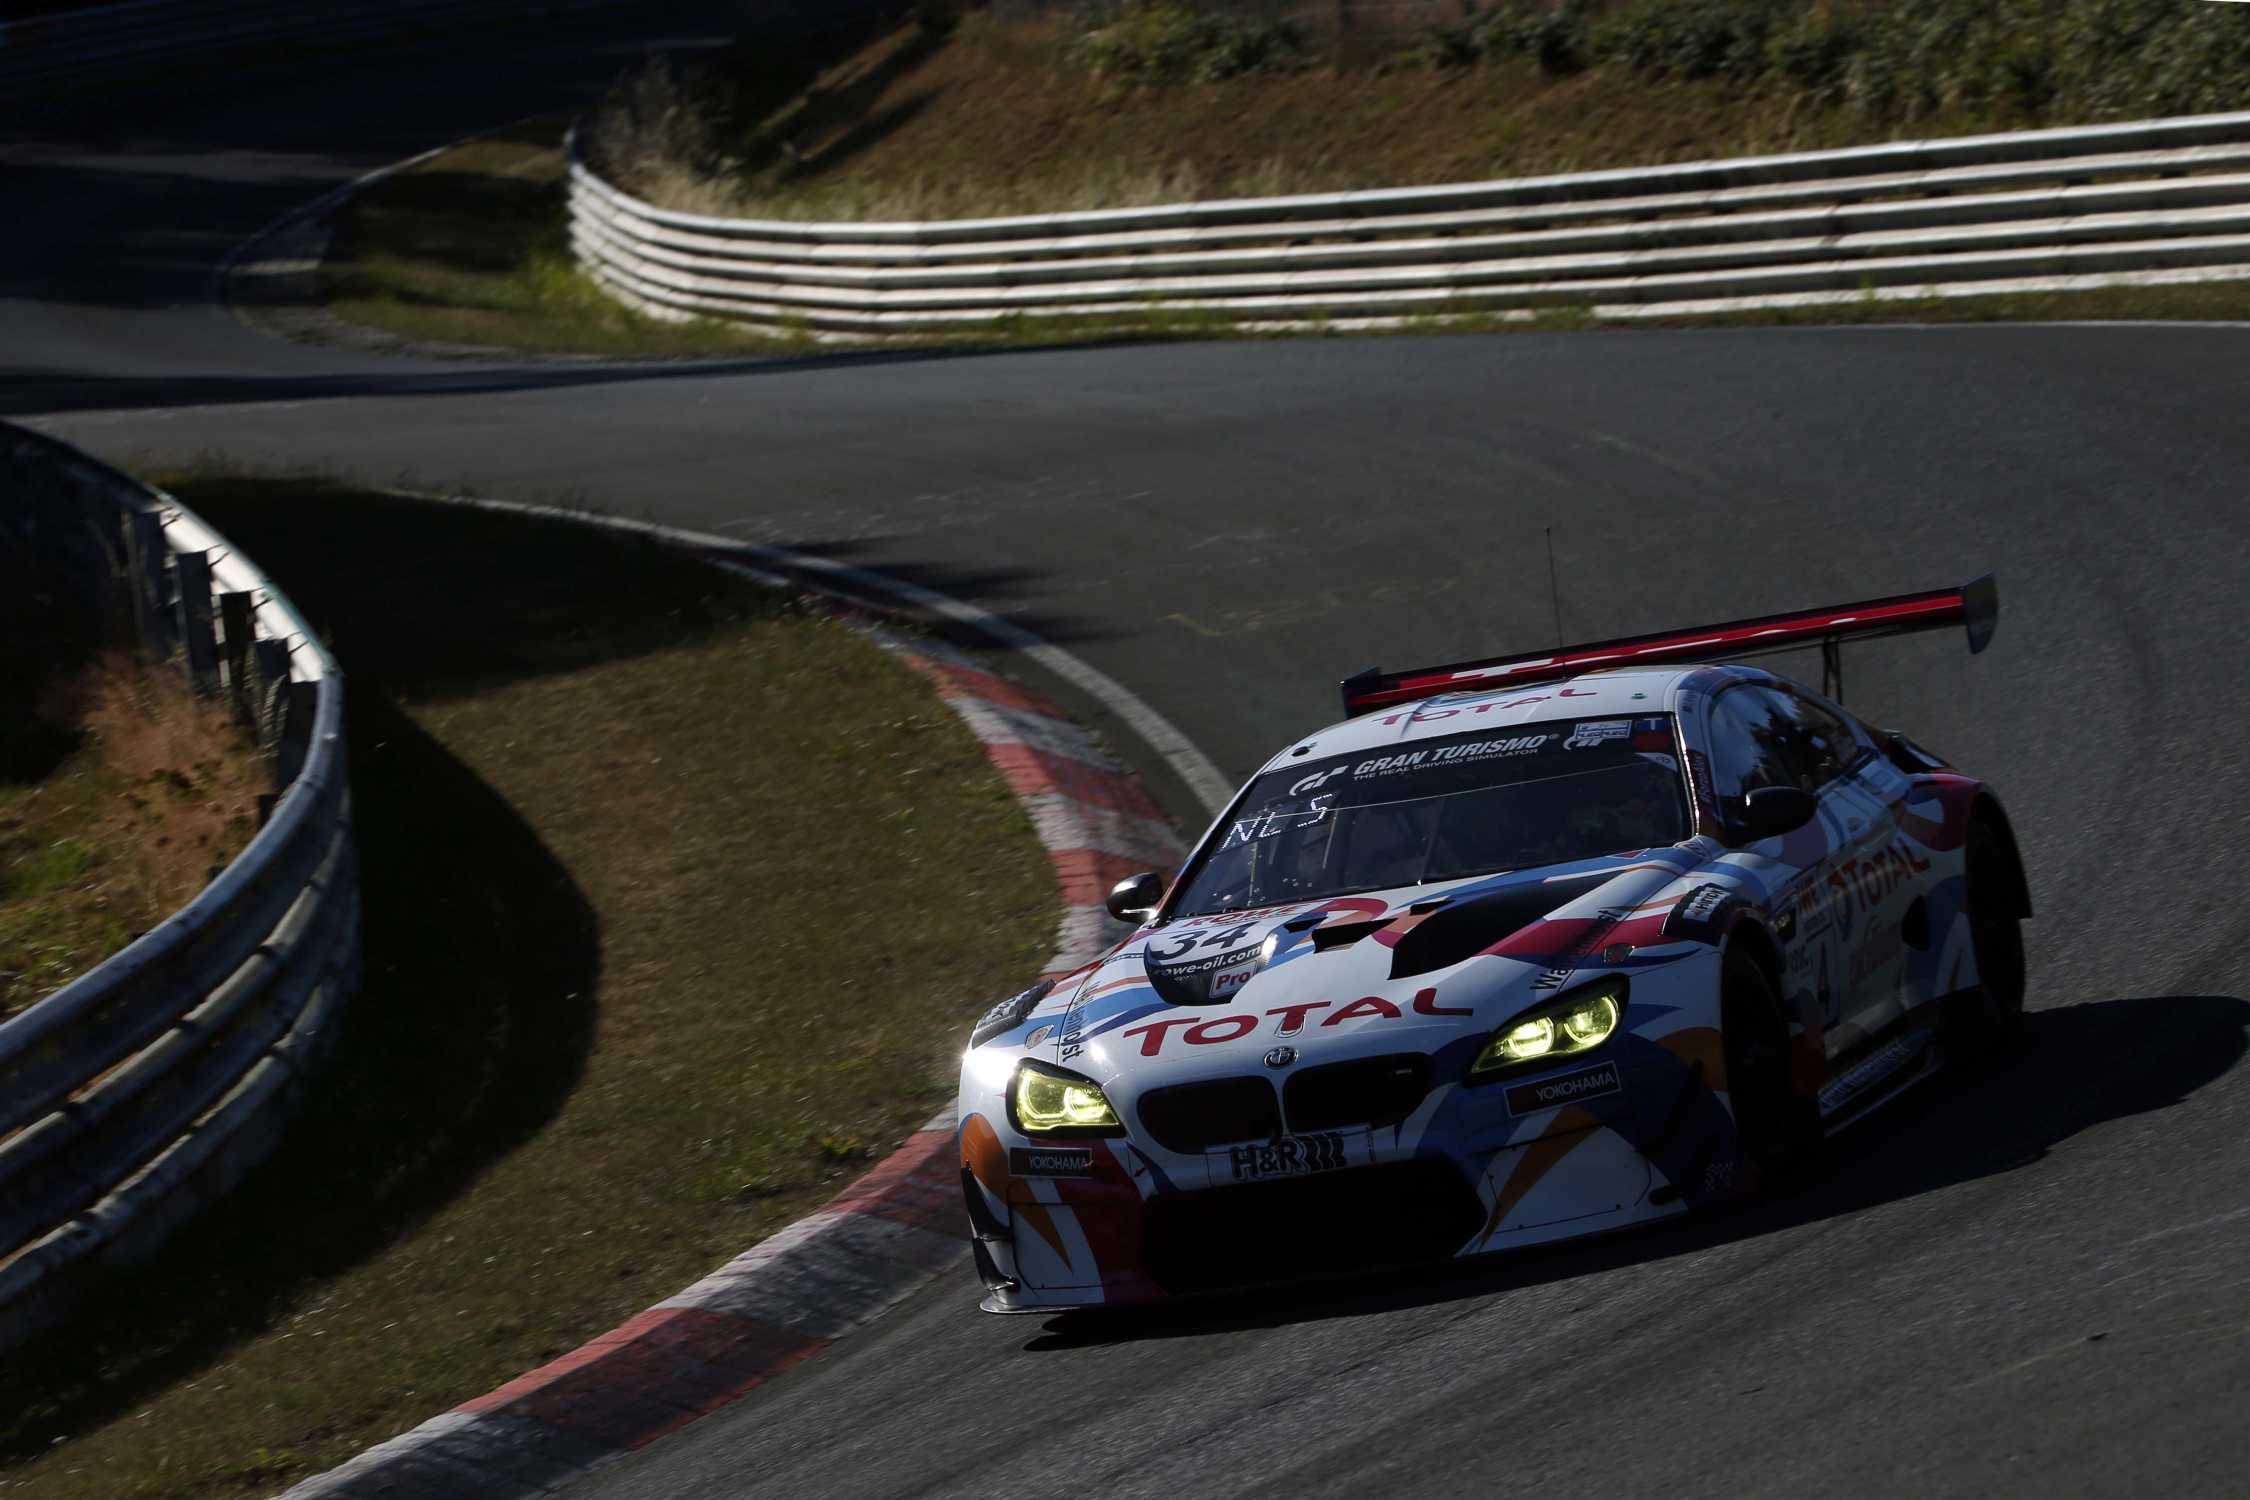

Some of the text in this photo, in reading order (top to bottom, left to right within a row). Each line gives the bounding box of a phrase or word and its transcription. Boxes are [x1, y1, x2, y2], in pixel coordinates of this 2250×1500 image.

[1374, 688, 1597, 725] TOTAL
[1353, 750, 1430, 776] GRAN
[1432, 734, 1550, 761] TURISMO
[1353, 749, 1538, 782] THE REAL DRIVING SIMULATOR
[1151, 920, 1260, 960] 34
[1123, 988, 1474, 1057] TOTAL
[1535, 1071, 1617, 1101] YOKOHAMA
[1028, 1154, 1089, 1170] YOKOHAMA
